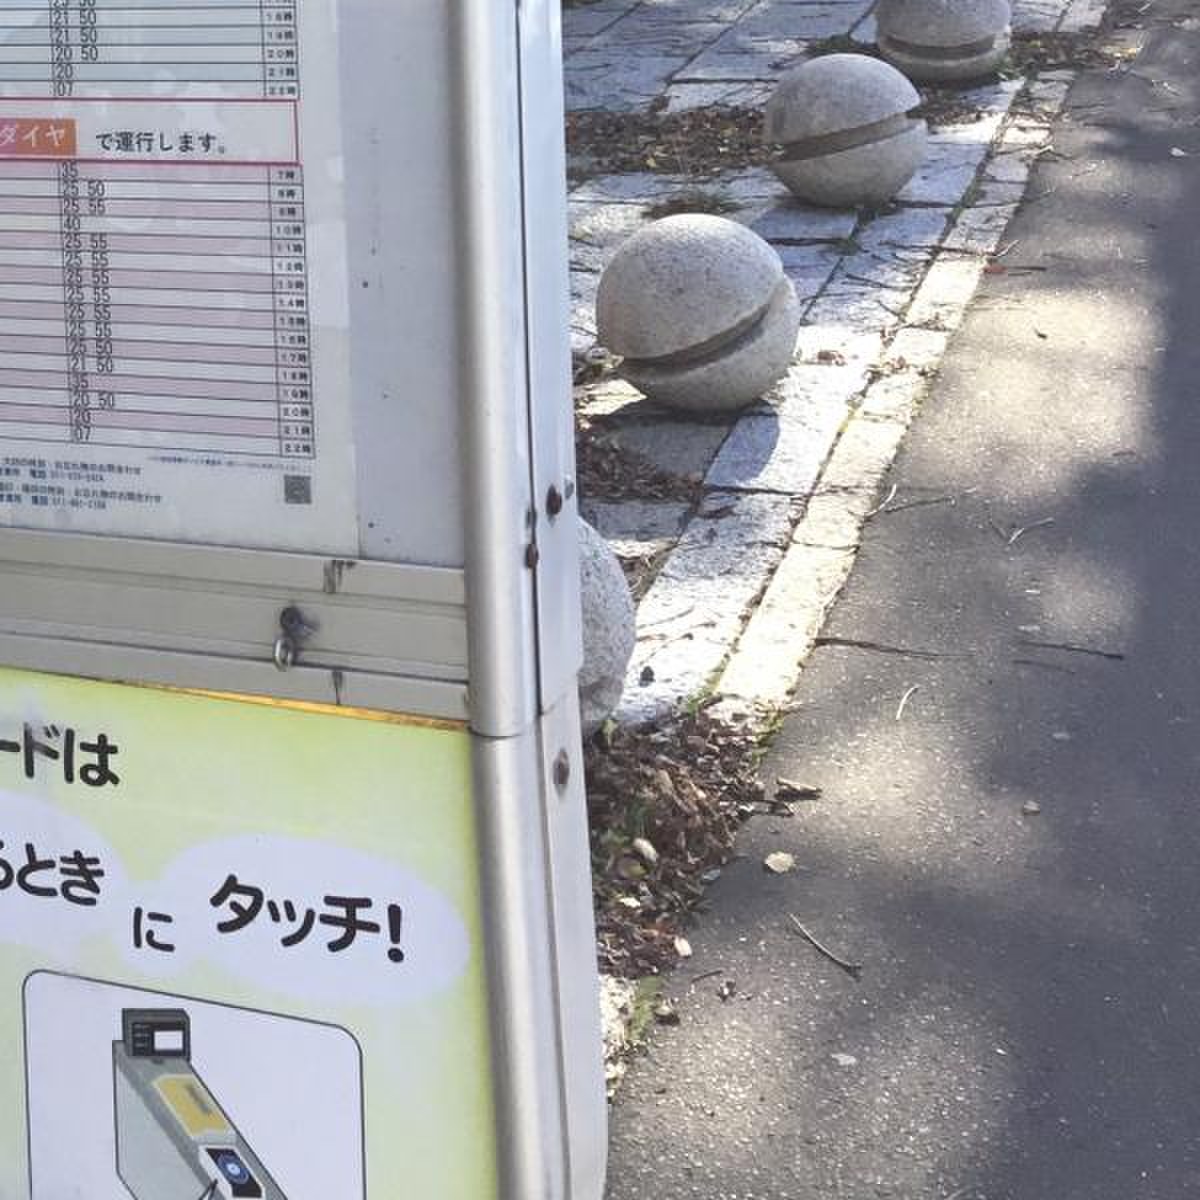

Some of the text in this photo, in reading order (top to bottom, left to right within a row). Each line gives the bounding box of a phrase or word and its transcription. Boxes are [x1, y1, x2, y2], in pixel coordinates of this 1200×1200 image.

[96, 131, 227, 154] で運行します。
[133, 907, 175, 952] に
